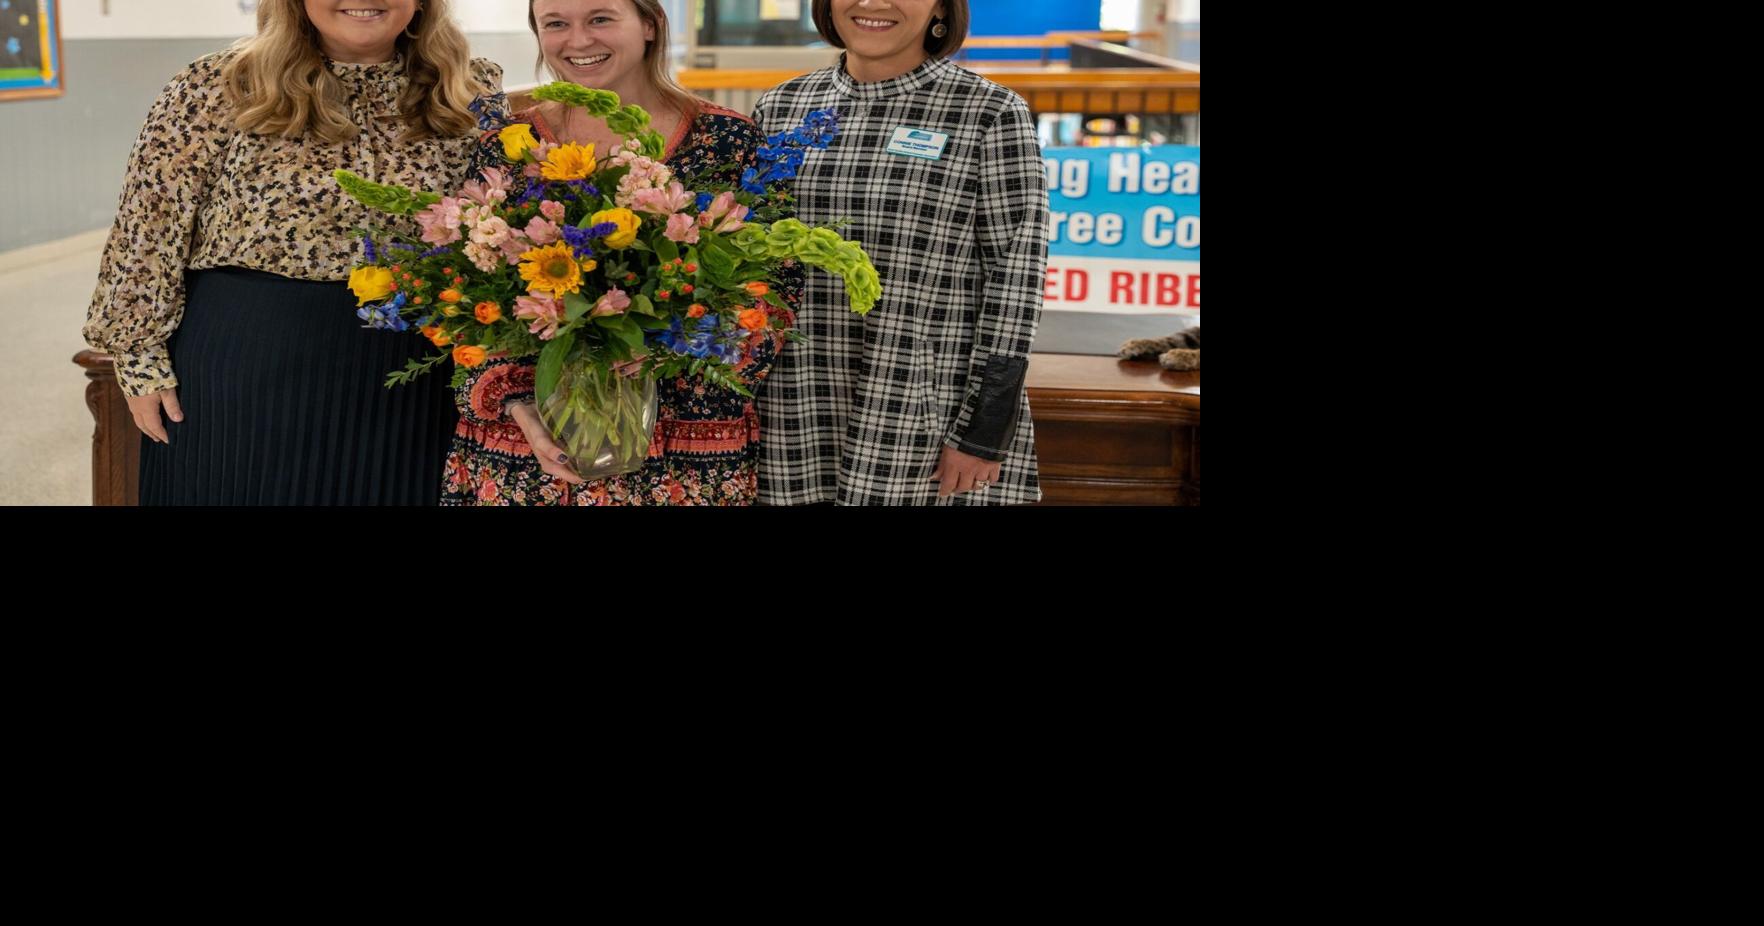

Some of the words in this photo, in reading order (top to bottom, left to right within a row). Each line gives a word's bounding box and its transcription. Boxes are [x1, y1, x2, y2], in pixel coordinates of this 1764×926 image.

[1108, 152, 1200, 195] Hea
[1048, 210, 1123, 245] ree
[1142, 205, 1200, 248] Co
